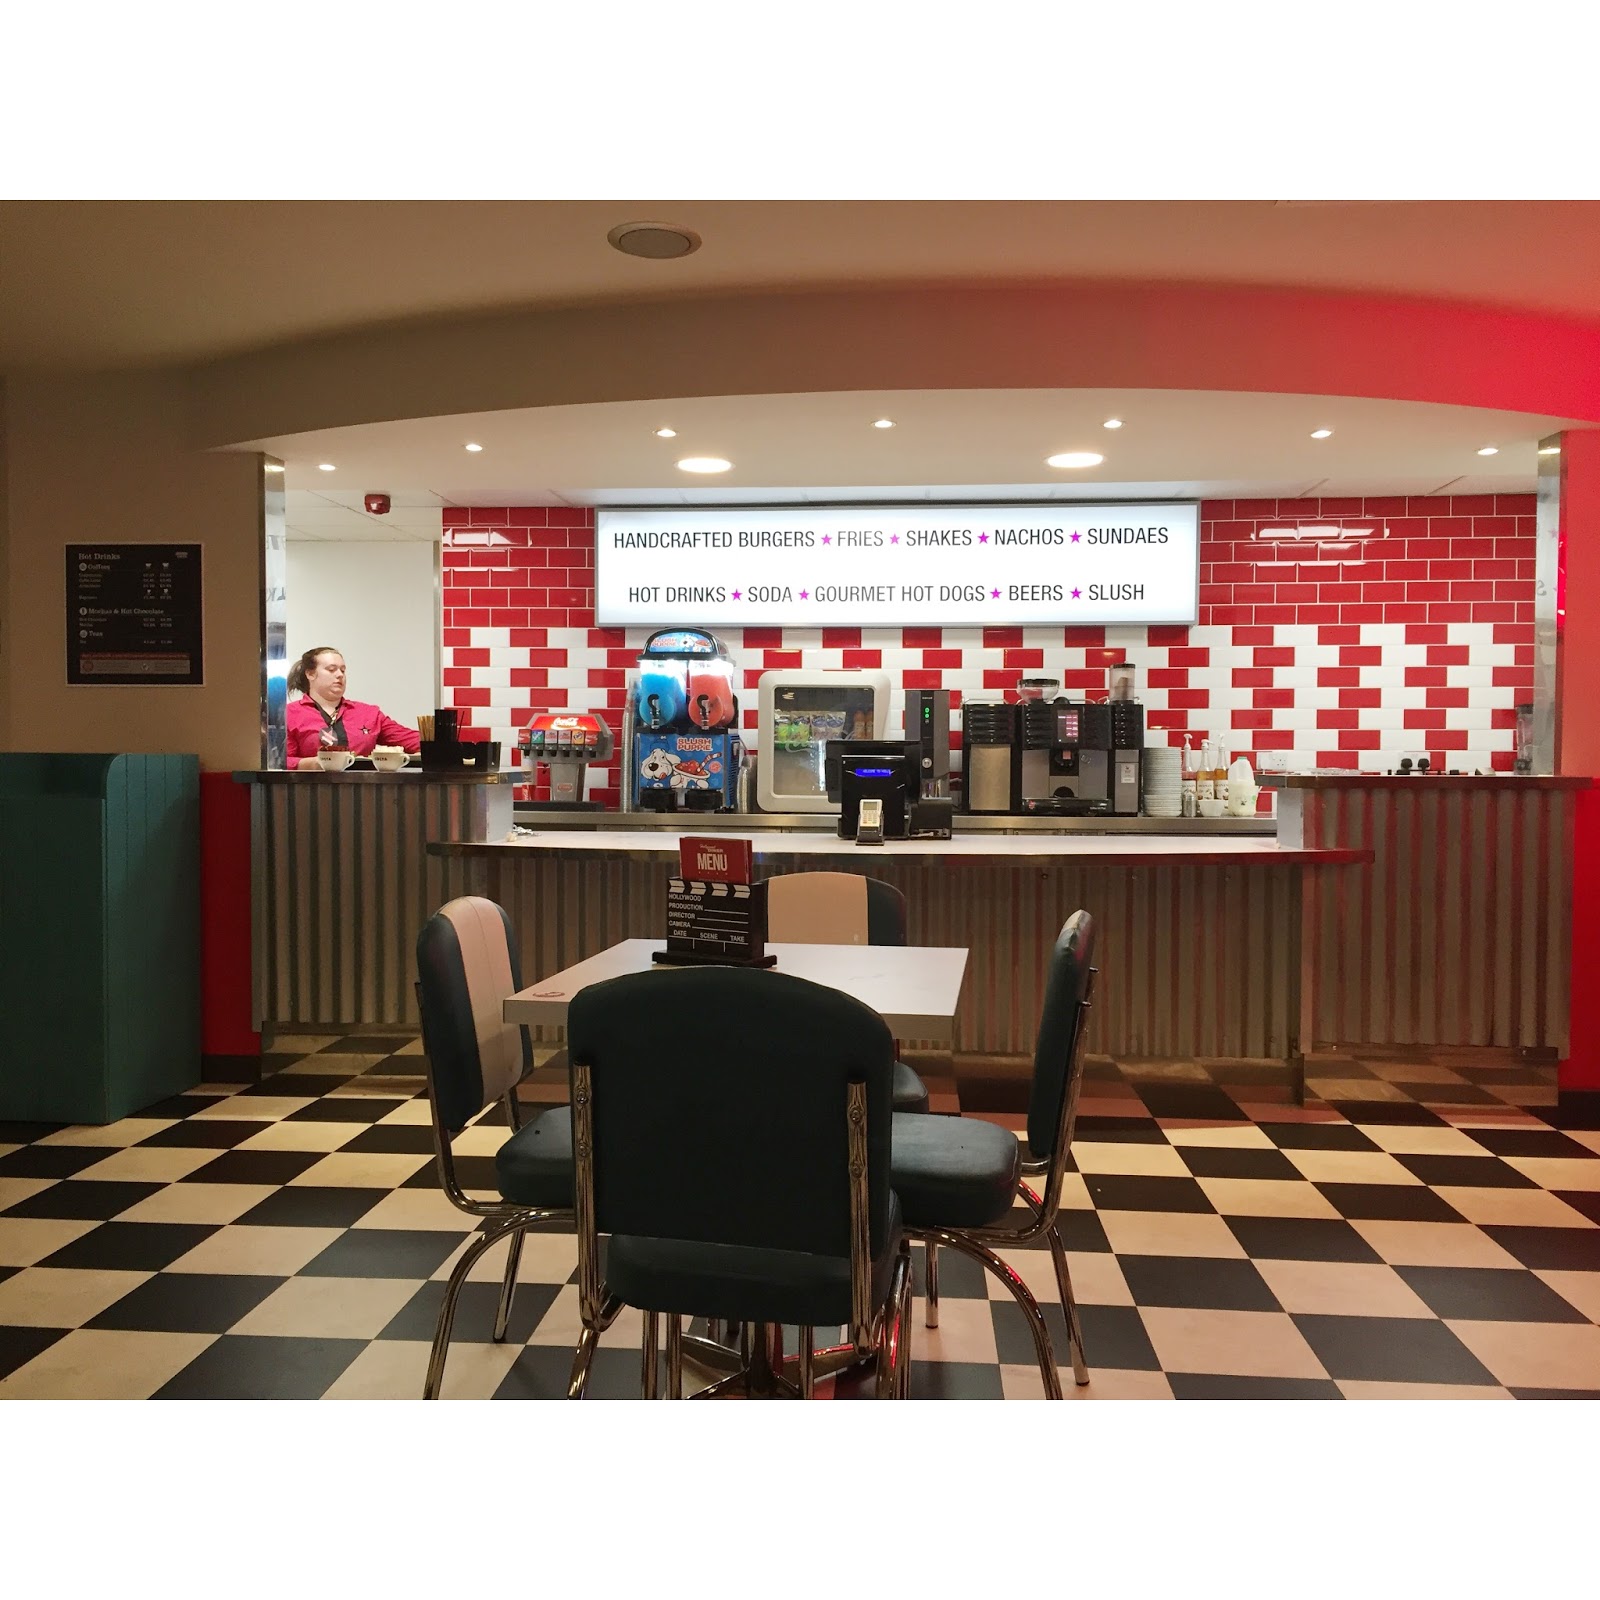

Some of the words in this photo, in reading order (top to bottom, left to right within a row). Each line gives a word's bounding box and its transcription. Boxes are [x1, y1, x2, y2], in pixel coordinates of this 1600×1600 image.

[615, 532, 732, 548] HANDCRAFTED
[739, 531, 814, 547] BURGERS
[838, 531, 883, 546] FRIES
[907, 530, 972, 546] SHAKES
[995, 529, 1063, 545] NACHOS
[1088, 527, 1168, 544] SUNDAES
[630, 587, 660, 602] HOT
[667, 587, 725, 602] DRINKS
[748, 587, 792, 602] SODA
[816, 586, 895, 602] GOURMET
[902, 586, 933, 601] HOT
[940, 586, 985, 601] DOGS
[1009, 585, 1063, 601] BEERS
[1089, 584, 1143, 600] SLUSH
[697, 852, 728, 871] MENU
[669, 893, 701, 901] HOLLYWOOD
[669, 903, 703, 911] PRODUCTION
